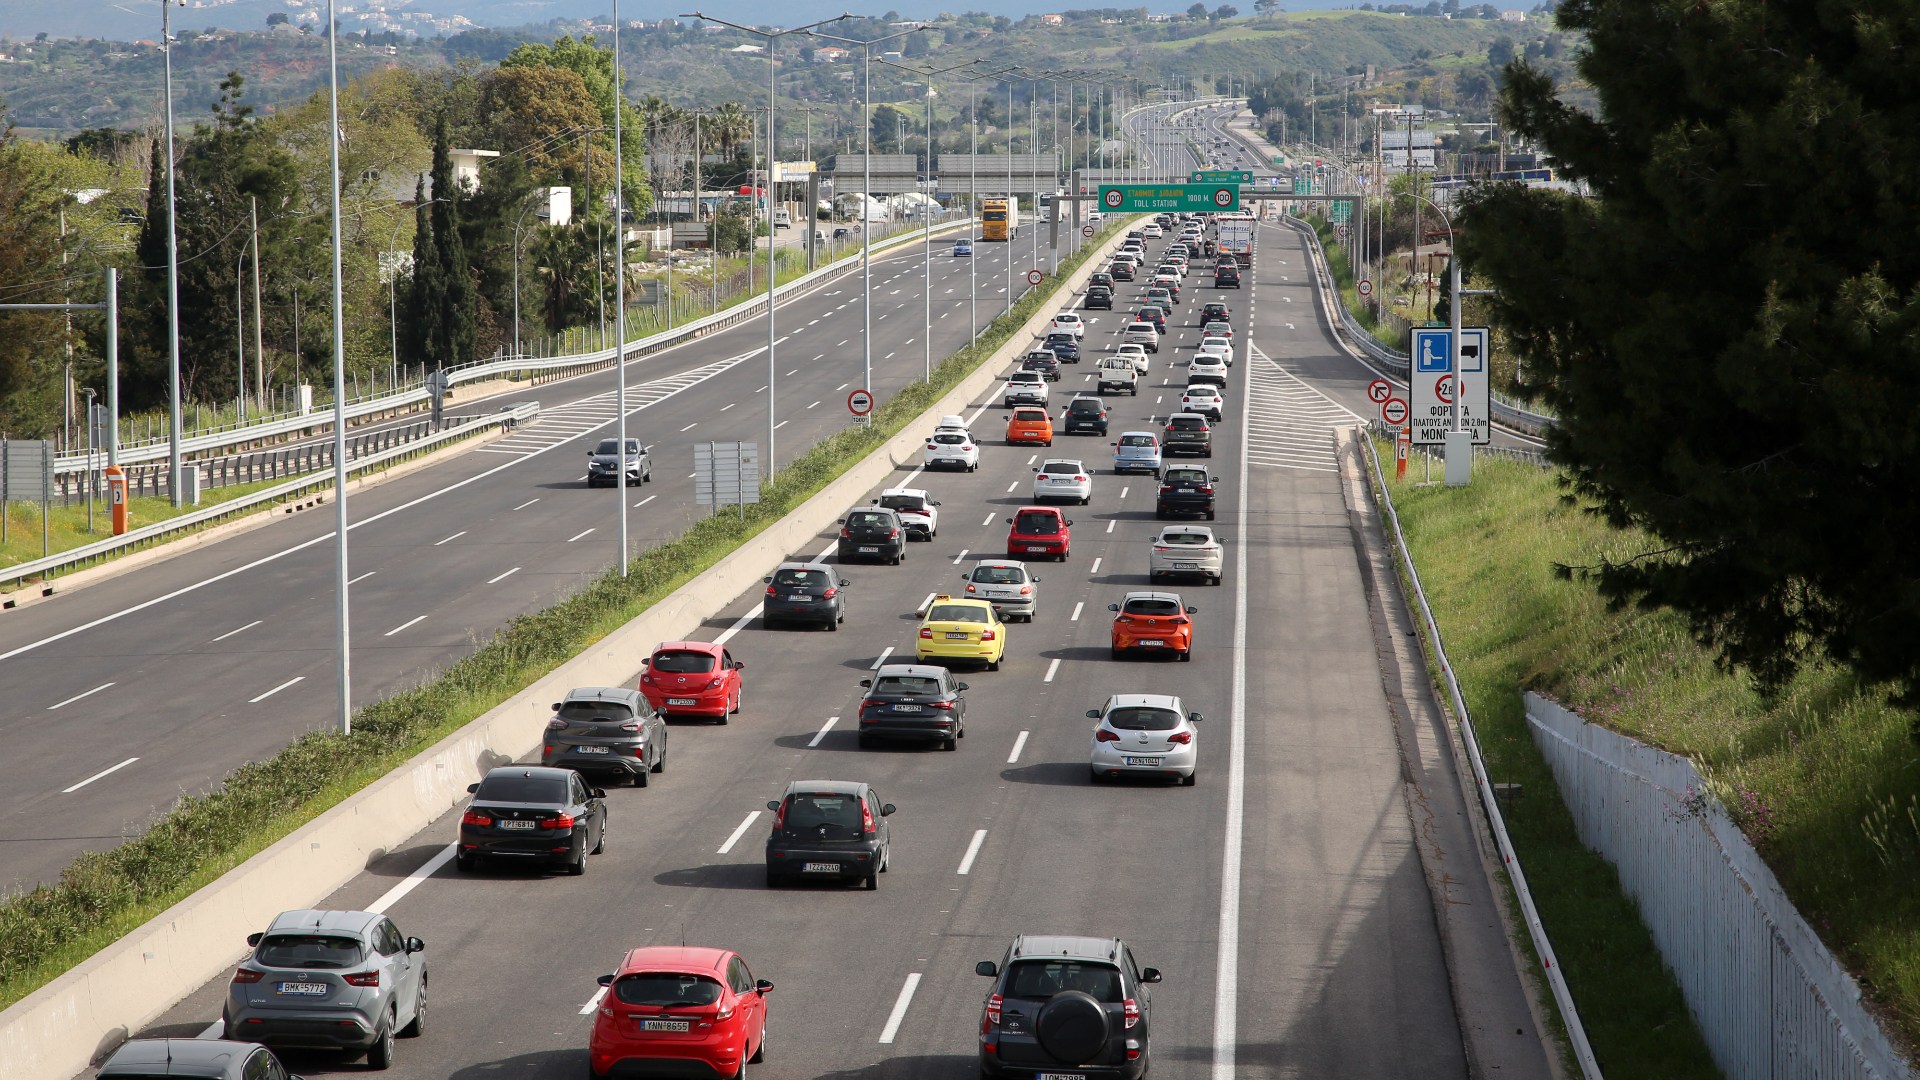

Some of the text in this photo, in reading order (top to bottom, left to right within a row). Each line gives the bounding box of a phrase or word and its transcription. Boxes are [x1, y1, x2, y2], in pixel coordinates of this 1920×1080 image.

[1108, 194, 1121, 203] 100
[1187, 194, 1202, 202] 1000
[1217, 193, 1230, 202] 100
[1134, 199, 1178, 208] TOLL STATION
[1430, 405, 1470, 416] ΦΟΡΤΑ
[1413, 418, 1441, 427] ΠΛΑΤΟΥΣ
